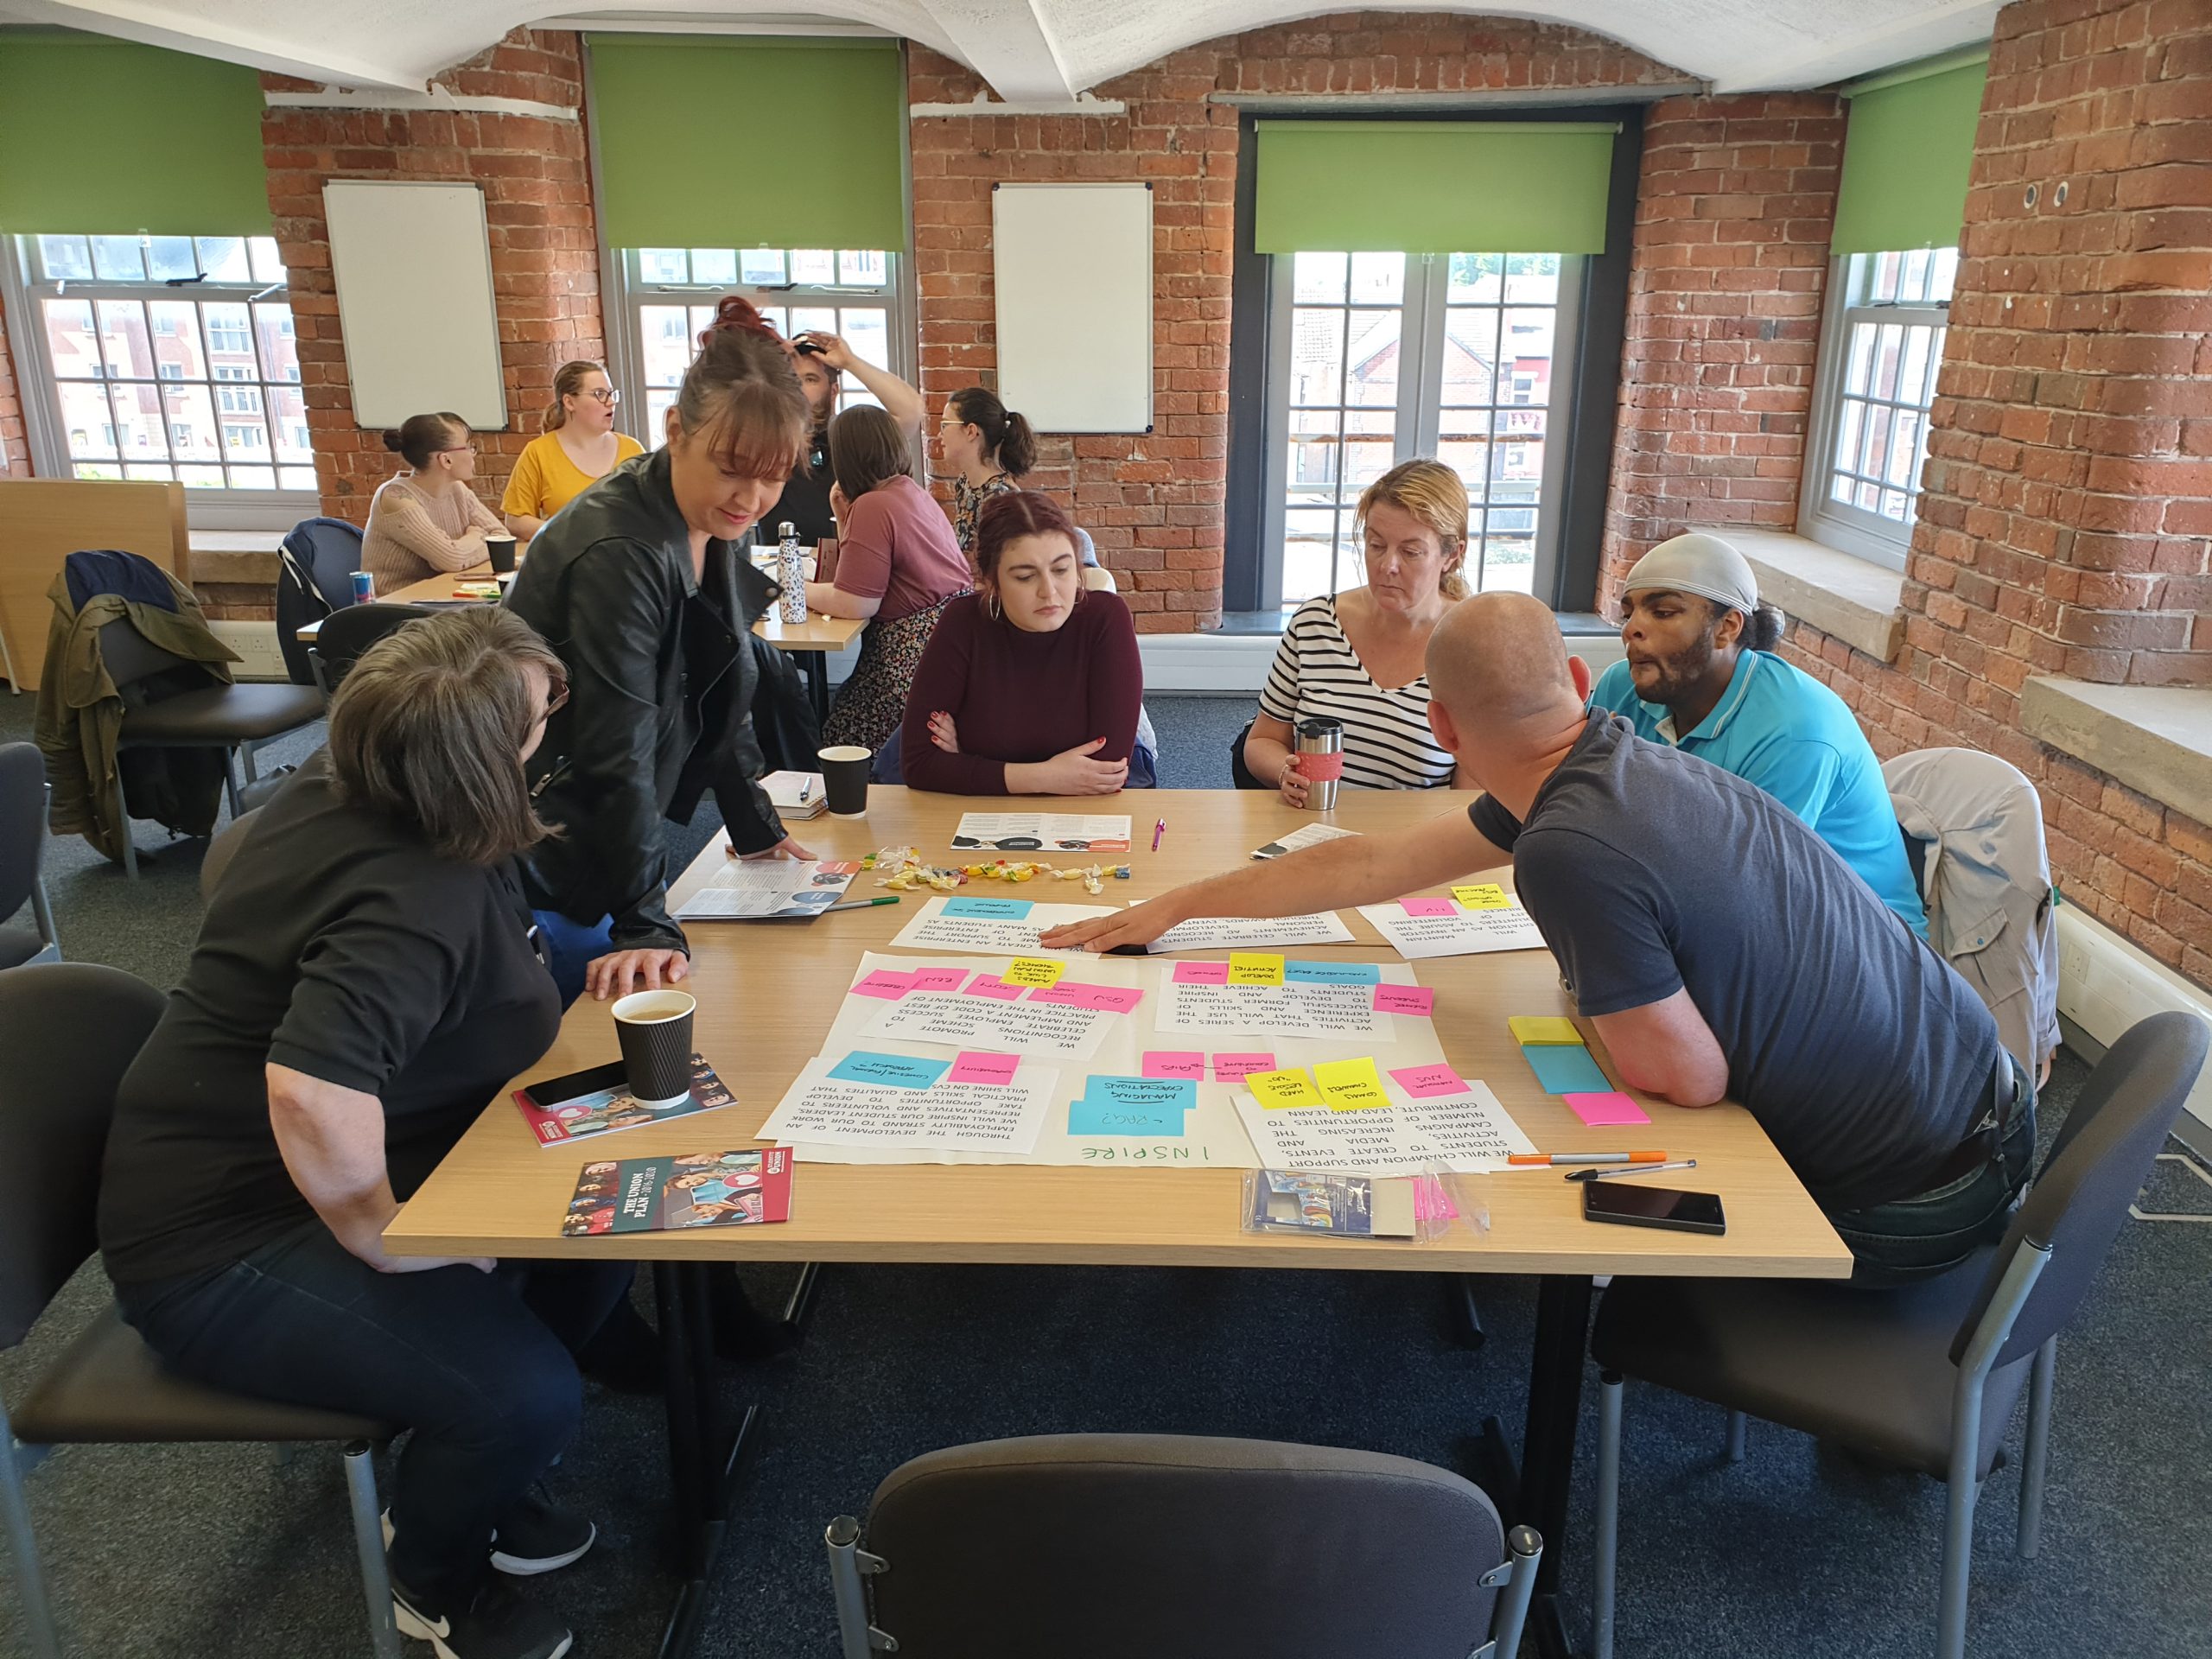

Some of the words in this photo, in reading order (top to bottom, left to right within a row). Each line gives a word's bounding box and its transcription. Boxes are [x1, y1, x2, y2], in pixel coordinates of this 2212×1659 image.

[921, 925, 981, 933] ENTERPRISE
[912, 935, 971, 944] ENTERPRISE
[927, 997, 1004, 1009] EMPLOYMENT
[1300, 1001, 1369, 1010] SUCCESSFUL
[898, 1008, 944, 1017] SUCCESS
[996, 1011, 1063, 1024] IMPLEMENT
[1044, 1009, 1096, 1020] PRACTICE
[1303, 1008, 1370, 1017] EXPERIENCE
[929, 1019, 976, 1028] SCHEME
[955, 1014, 1014, 1026] EMPLOYEE
[1258, 1020, 1310, 1028] DEVELOP
[1311, 1015, 1371, 1024] ACTIVITIES
[918, 1025, 976, 1036] PROMOTE
[1025, 1022, 1086, 1034] CELEBRATE
[997, 1027, 1081, 1041] RECOGNITIONS
[1003, 1034, 1028, 1044] WILL
[844, 1087, 898, 1096] QUALITIES
[1104, 1082, 1184, 1091] EXPECTATIONS
[1327, 1083, 1367, 1093] CHANNELS
[805, 1093, 854, 1102] DEVELOP
[971, 1092, 1027, 1103] PRACTICAL
[1111, 1090, 1177, 1100] MANAGING
[822, 1102, 890, 1110] VOLUNTEERS
[899, 1097, 982, 1107] OPPORTUNITIES
[798, 1108, 846, 1116] LEADERS,
[925, 1106, 1020, 1117] REPRESENTATIVES
[1395, 1102, 1478, 1113] CONTRIBUTE,
[1293, 1116, 1394, 1126] OPPORTUNITIES
[1427, 1111, 1485, 1121] NUMBER
[834, 1126, 917, 1135] DEVELOPMENT
[931, 1122, 1014, 1132] EMPLOYABILITY
[1317, 1126, 1395, 1135] INCREASING
[1414, 1121, 1492, 1132] CAMPAIGNS
[956, 1130, 1011, 1140] THROUGH
[1271, 1129, 1298, 1138] THE
[1427, 1130, 1498, 1140] ACTIVITIES,
[1344, 1136, 1389, 1145] MEDIA
[1440, 1140, 1508, 1149] STUDENTS
[1081, 1146, 1209, 1160] INSPIRE
[1281, 1148, 1335, 1157] EVENTS,
[1347, 1146, 1397, 1155] CREATE
[1287, 1159, 1349, 1167] SUPPORT
[1350, 1157, 1379, 1166] AND
[1382, 1152, 1457, 1164] CHAMPION
[627, 1173, 645, 1198] UNION
[623, 1198, 638, 1214] THE
[633, 1197, 650, 1218] PLAN
